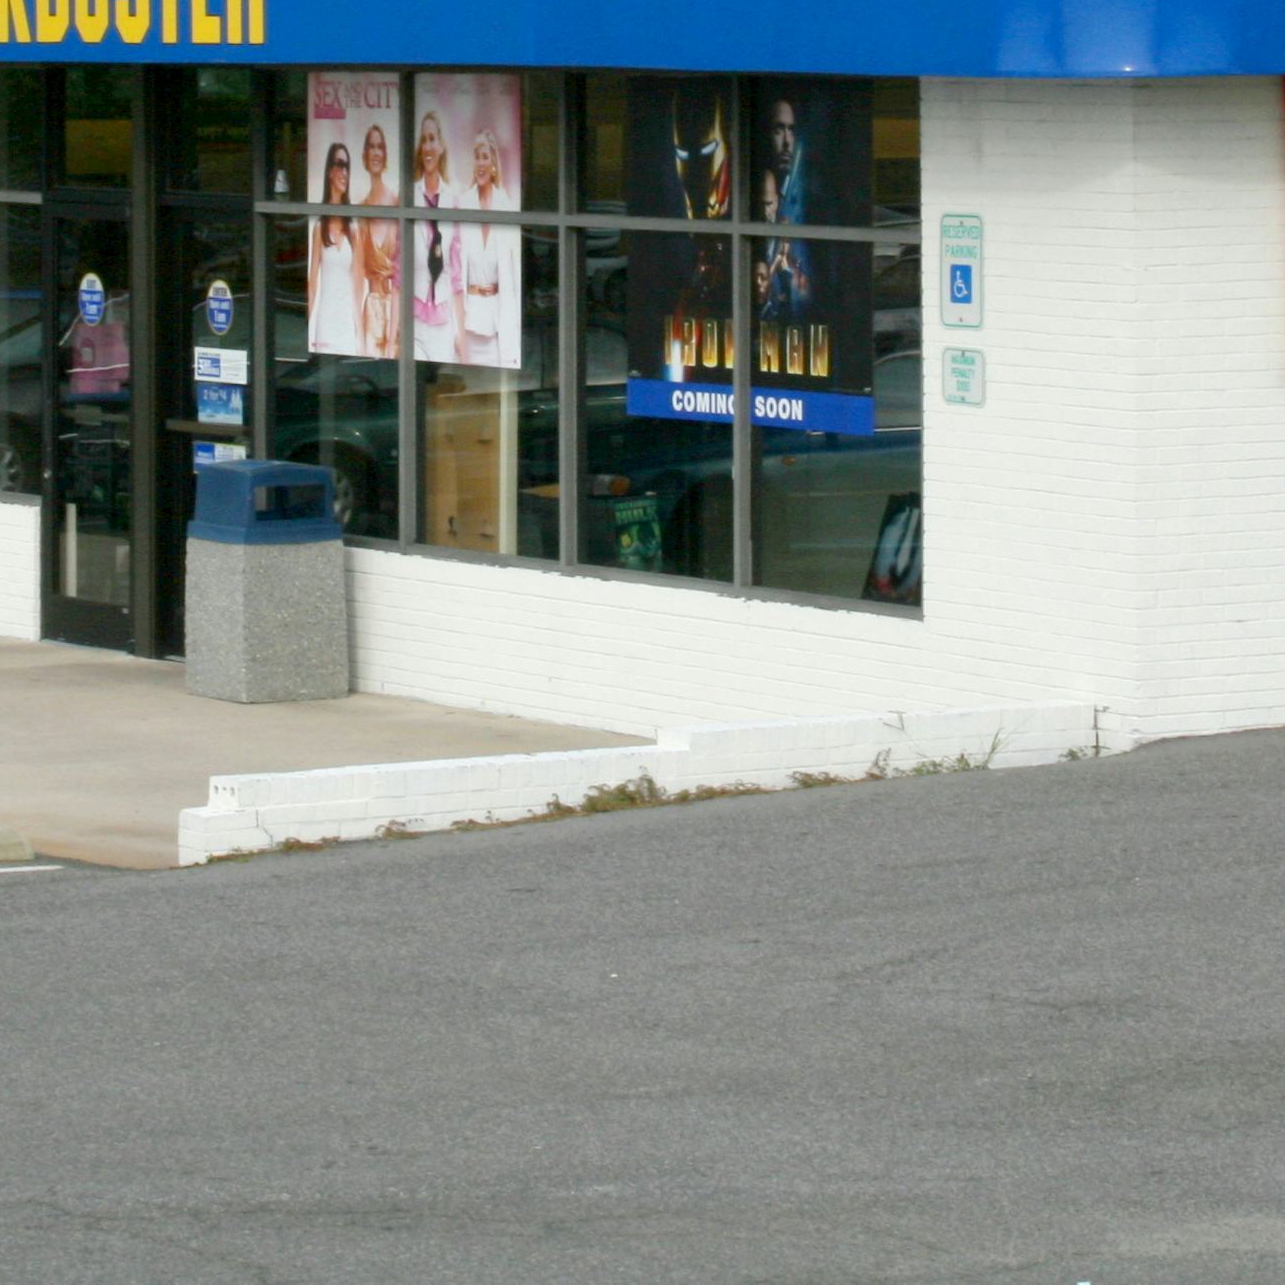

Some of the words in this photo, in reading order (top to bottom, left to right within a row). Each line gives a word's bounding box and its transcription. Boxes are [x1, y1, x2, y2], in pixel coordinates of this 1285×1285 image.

[364, 80, 401, 109] CIT
[943, 225, 981, 239] RESERVED
[945, 245, 978, 259] PARKING
[759, 320, 829, 378] MAN
[755, 395, 803, 421] SOON
